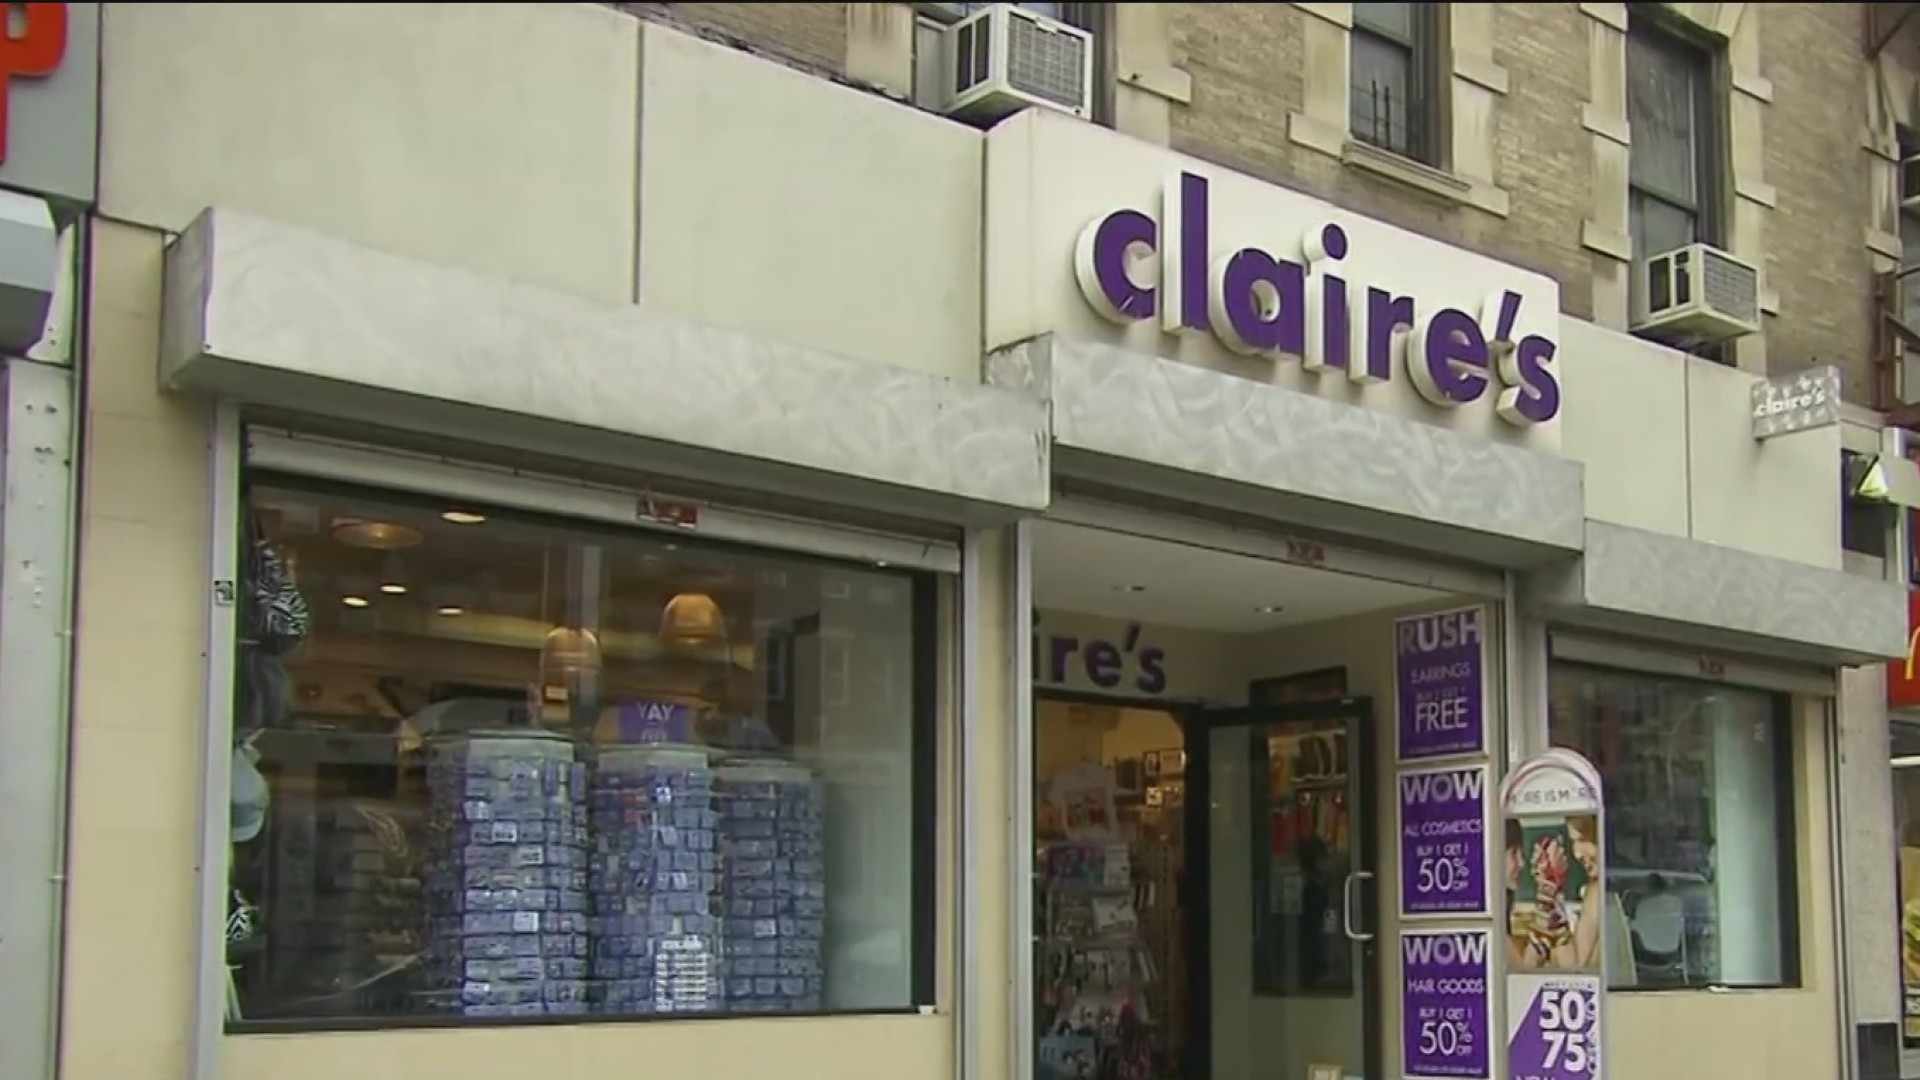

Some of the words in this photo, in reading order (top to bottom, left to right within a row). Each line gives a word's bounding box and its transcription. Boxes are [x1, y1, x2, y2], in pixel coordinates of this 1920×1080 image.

[1076, 170, 1560, 425] claire's
[636, 701, 674, 721] YAY
[1415, 697, 1469, 733] FREE
[1402, 770, 1484, 804] WOW
[1403, 935, 1487, 965] WOW
[1437, 977, 1484, 994] GOODS
[1540, 990, 1585, 1032] 50
[1542, 1031, 1586, 1073] 75
